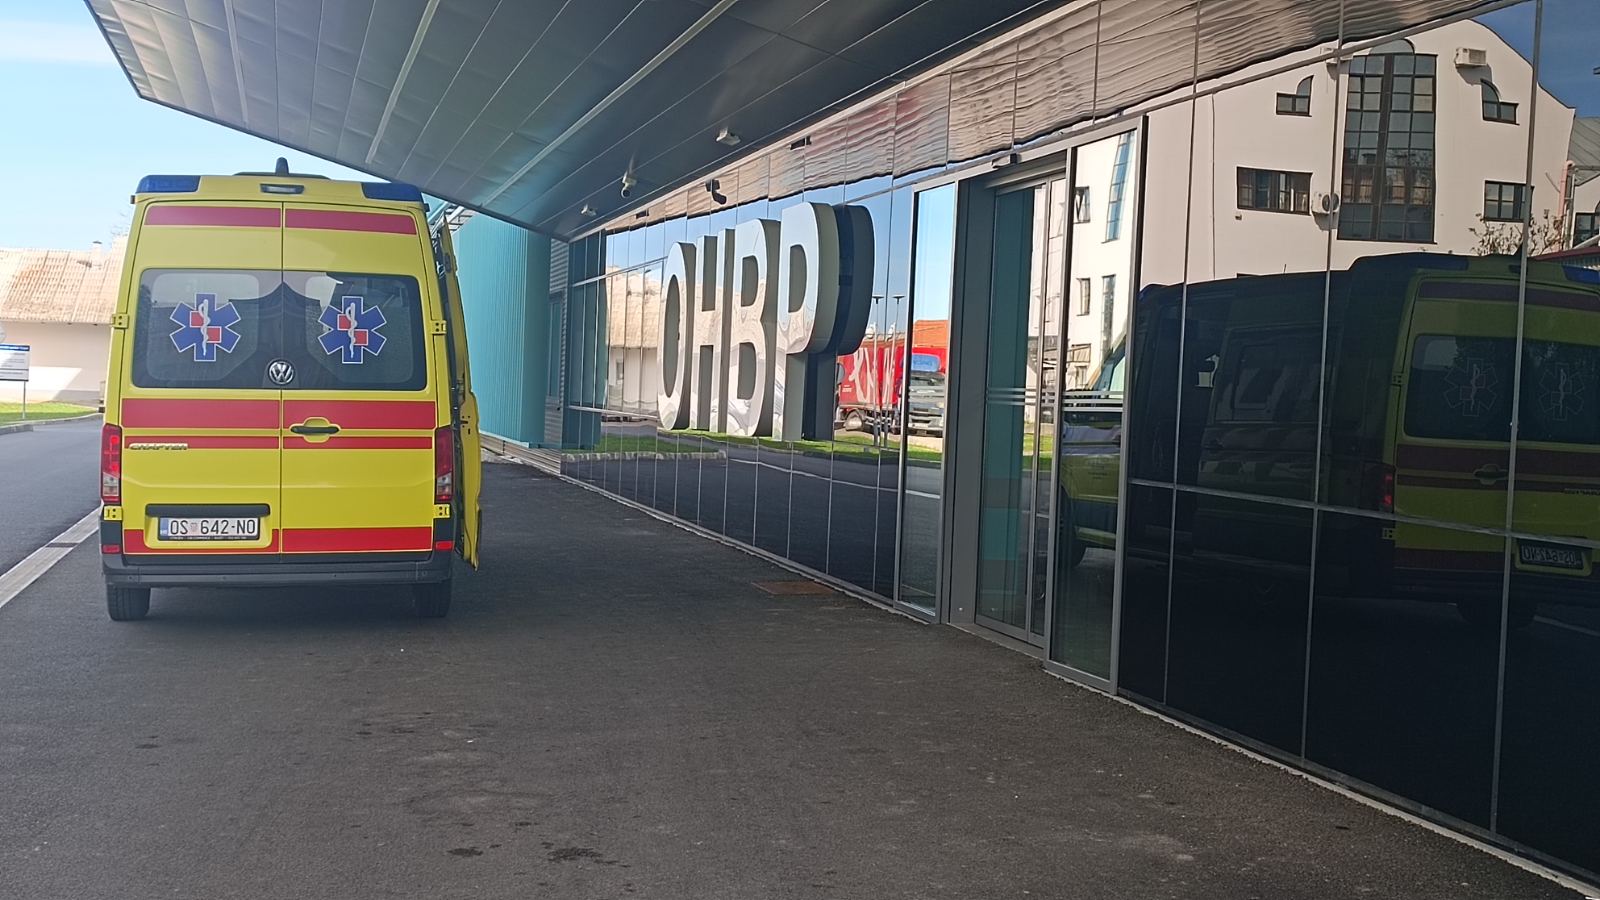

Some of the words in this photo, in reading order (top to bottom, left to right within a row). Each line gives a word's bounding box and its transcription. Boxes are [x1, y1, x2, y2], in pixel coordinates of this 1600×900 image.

[657, 201, 822, 442] OHBP
[170, 519, 188, 535] OS
[200, 519, 256, 535] 642-NO
